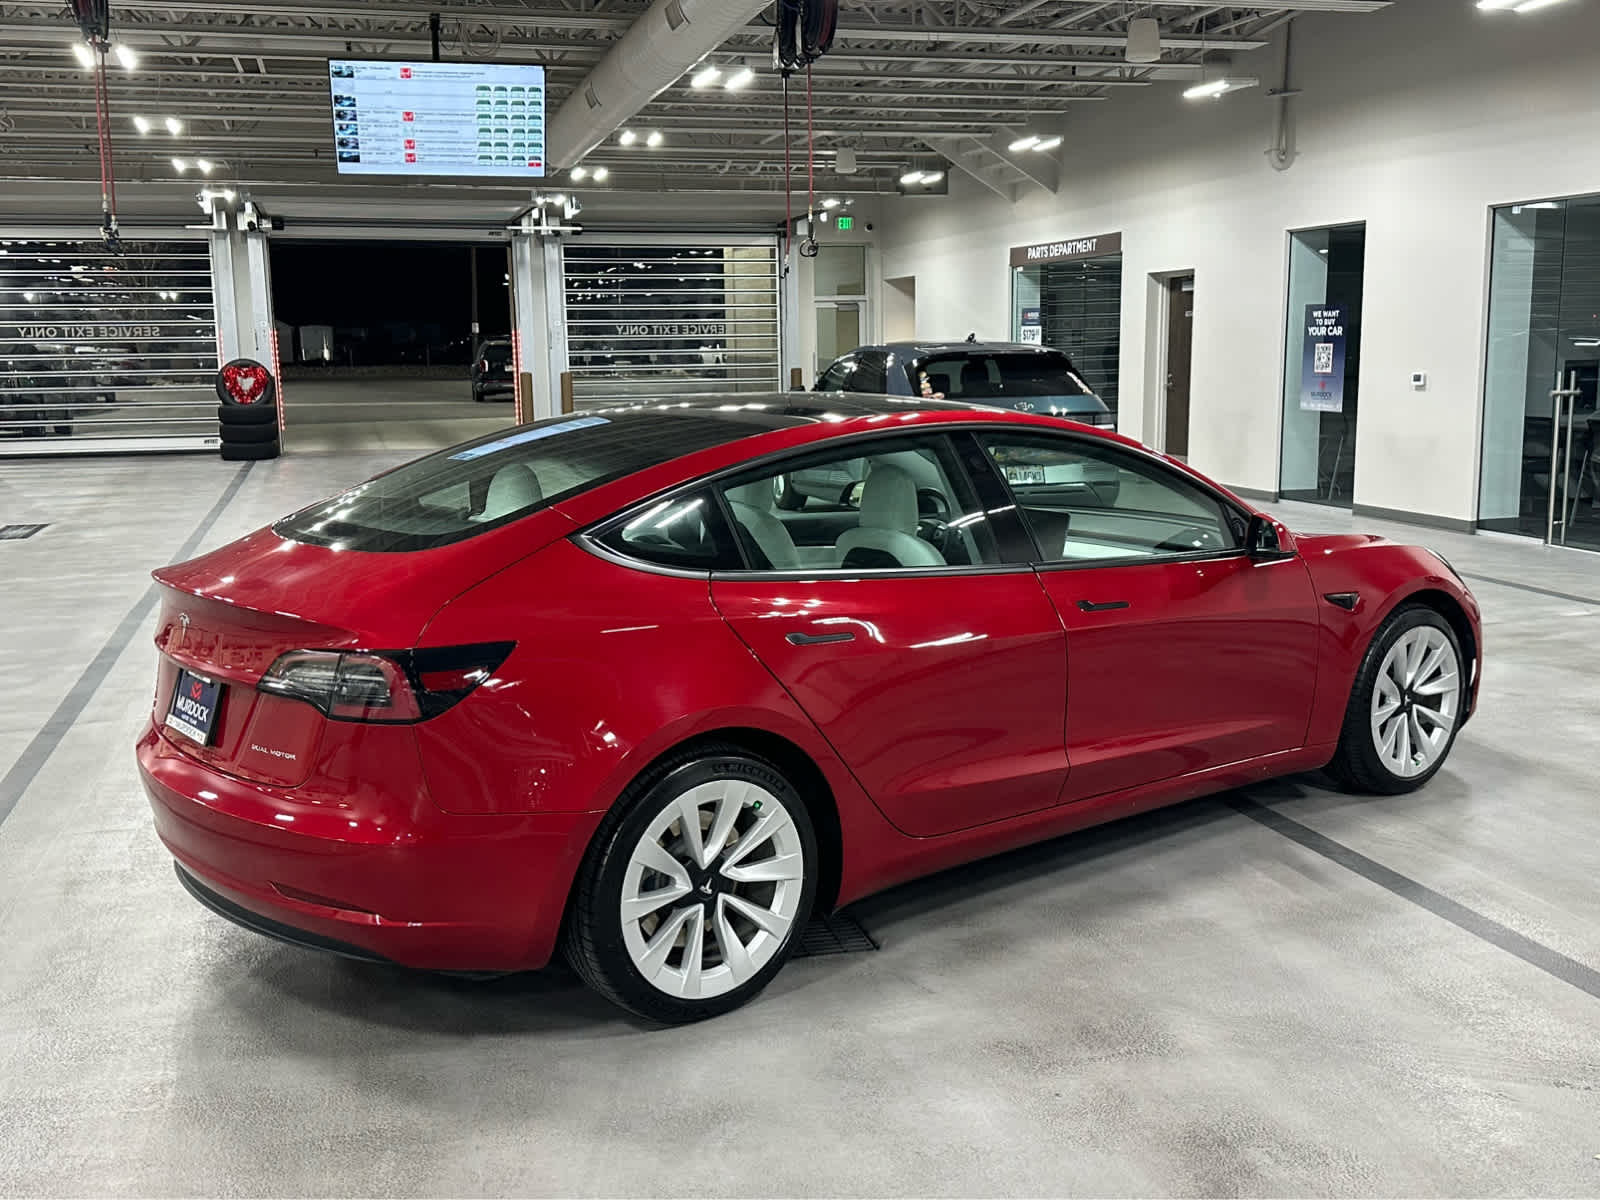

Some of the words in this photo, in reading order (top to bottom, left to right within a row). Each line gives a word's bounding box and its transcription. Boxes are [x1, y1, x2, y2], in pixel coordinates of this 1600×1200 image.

[1027, 245, 1049, 260] PARTS
[1049, 239, 1097, 257] DEPARTMENT
[1312, 310, 1322, 318] WE
[1322, 310, 1340, 318] WANT
[1315, 318, 1323, 326] TO
[1323, 318, 1336, 326] BUY
[1307, 326, 1327, 336] YOUR
[1327, 326, 1343, 336] CAR
[176, 693, 209, 723] MURDOCK
[251, 743, 269, 754] DUAL
[270, 749, 296, 760] MOTOR
